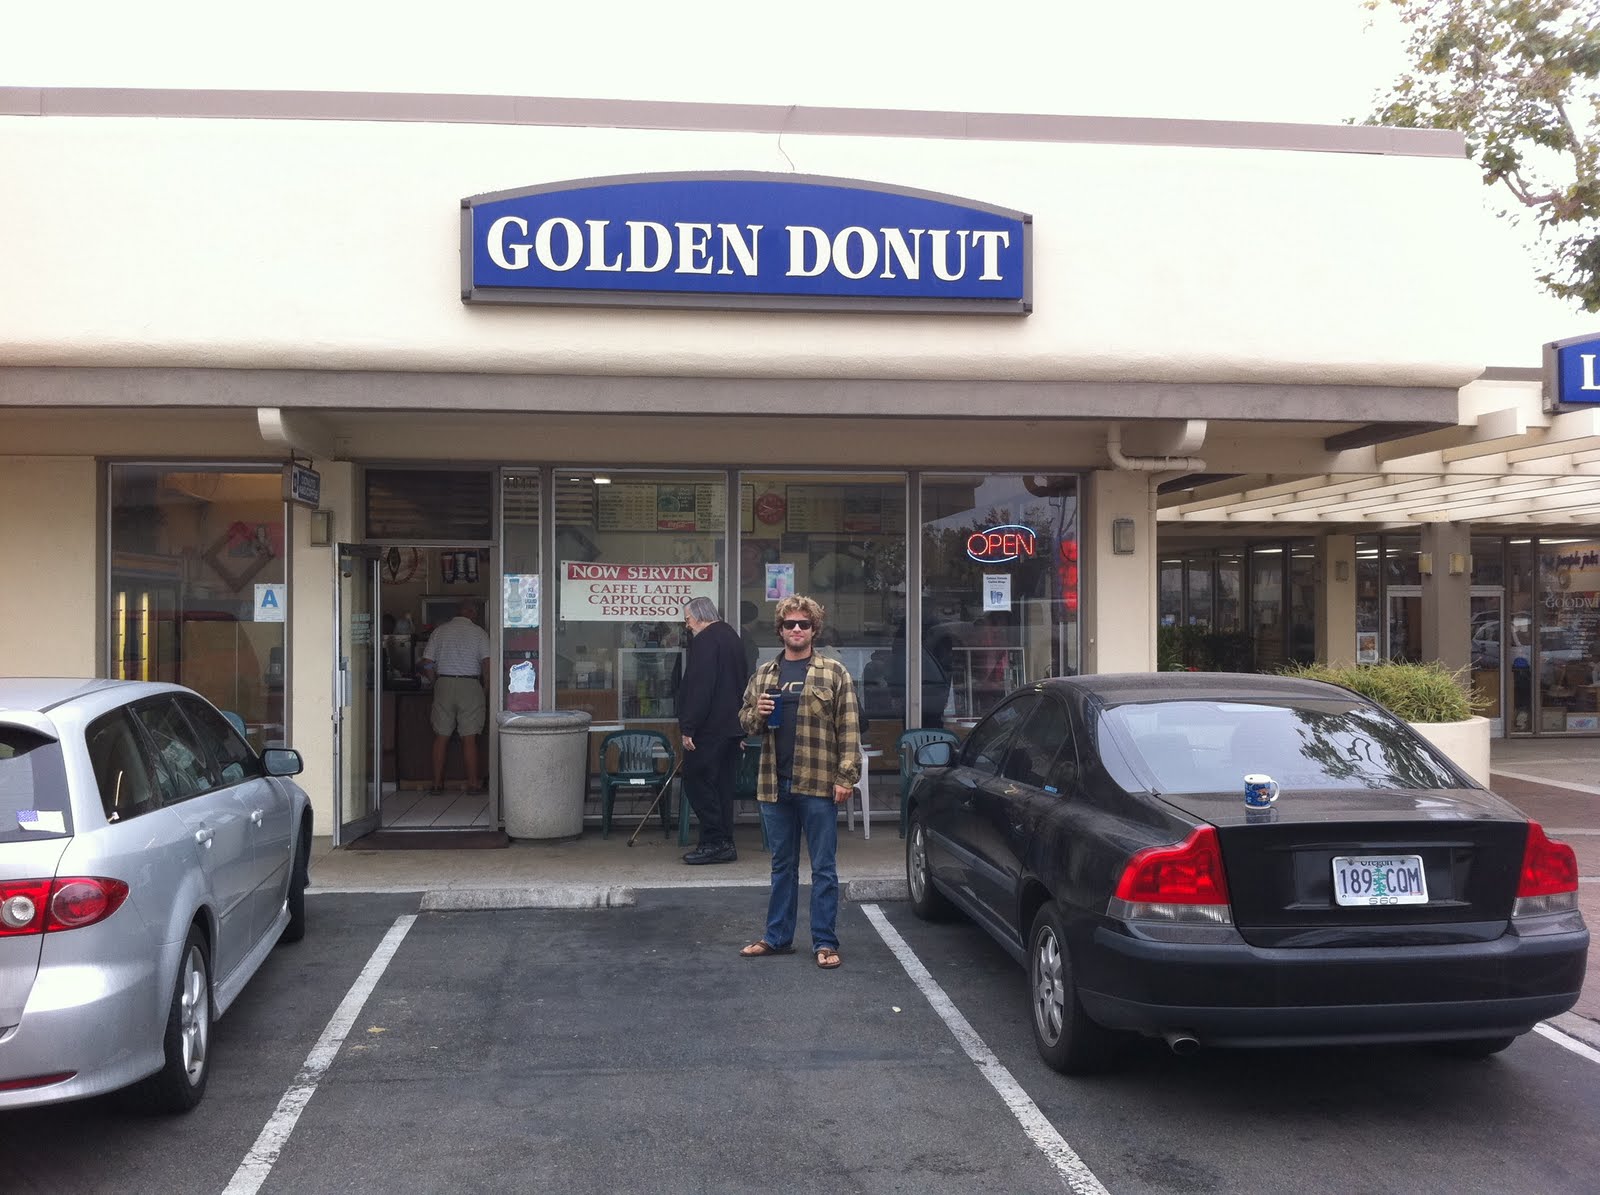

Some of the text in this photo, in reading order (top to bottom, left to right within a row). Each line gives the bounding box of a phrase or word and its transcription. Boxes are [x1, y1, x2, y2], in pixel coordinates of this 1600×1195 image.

[486, 215, 1010, 282] GOLDEN DONUT
[966, 533, 1034, 556] OPEN
[571, 565, 709, 580] NOW SERVING
[589, 583, 692, 595] CAFFE LATTE
[260, 589, 279, 608] A
[588, 595, 692, 606] CAPPUCCINO
[602, 606, 679, 616] ESPRESSO
[1340, 867, 1421, 896] 189 CQM
[1368, 896, 1398, 905] S60
